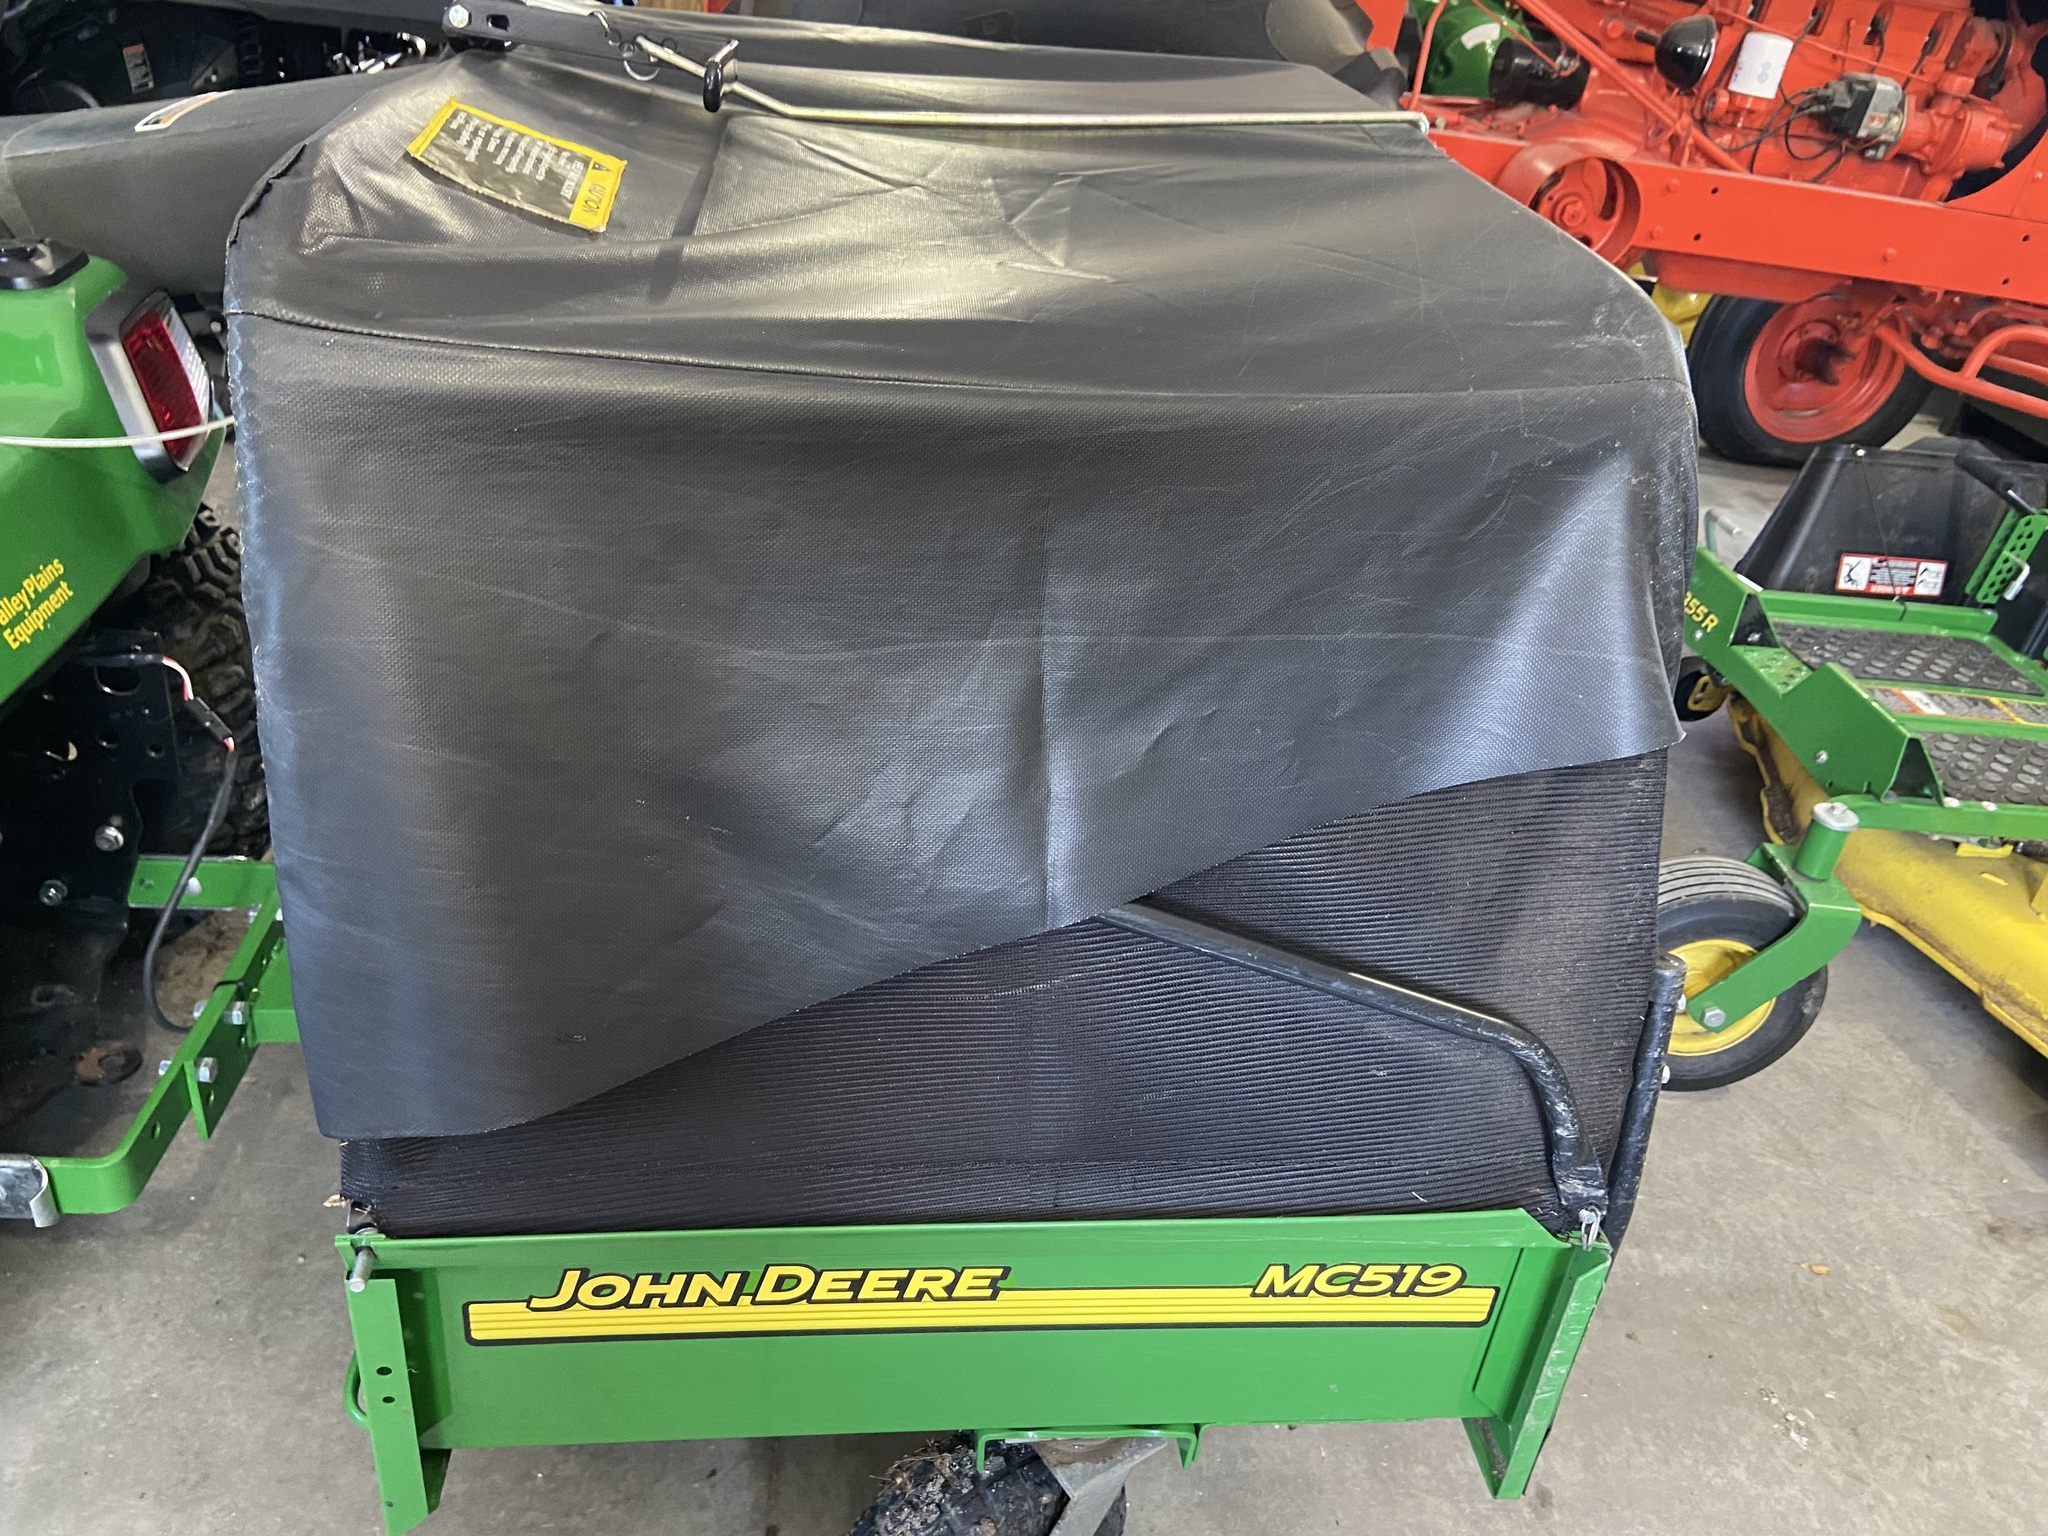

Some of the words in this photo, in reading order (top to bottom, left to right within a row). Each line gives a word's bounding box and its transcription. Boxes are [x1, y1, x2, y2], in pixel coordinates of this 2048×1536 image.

[0, 588, 32, 626] alley
[22, 558, 65, 600] Plains
[2, 580, 74, 650] Equipment
[527, 1267, 749, 1312] JOHN
[751, 1264, 1012, 1304] DEERE
[1250, 1262, 1468, 1298] MC519
